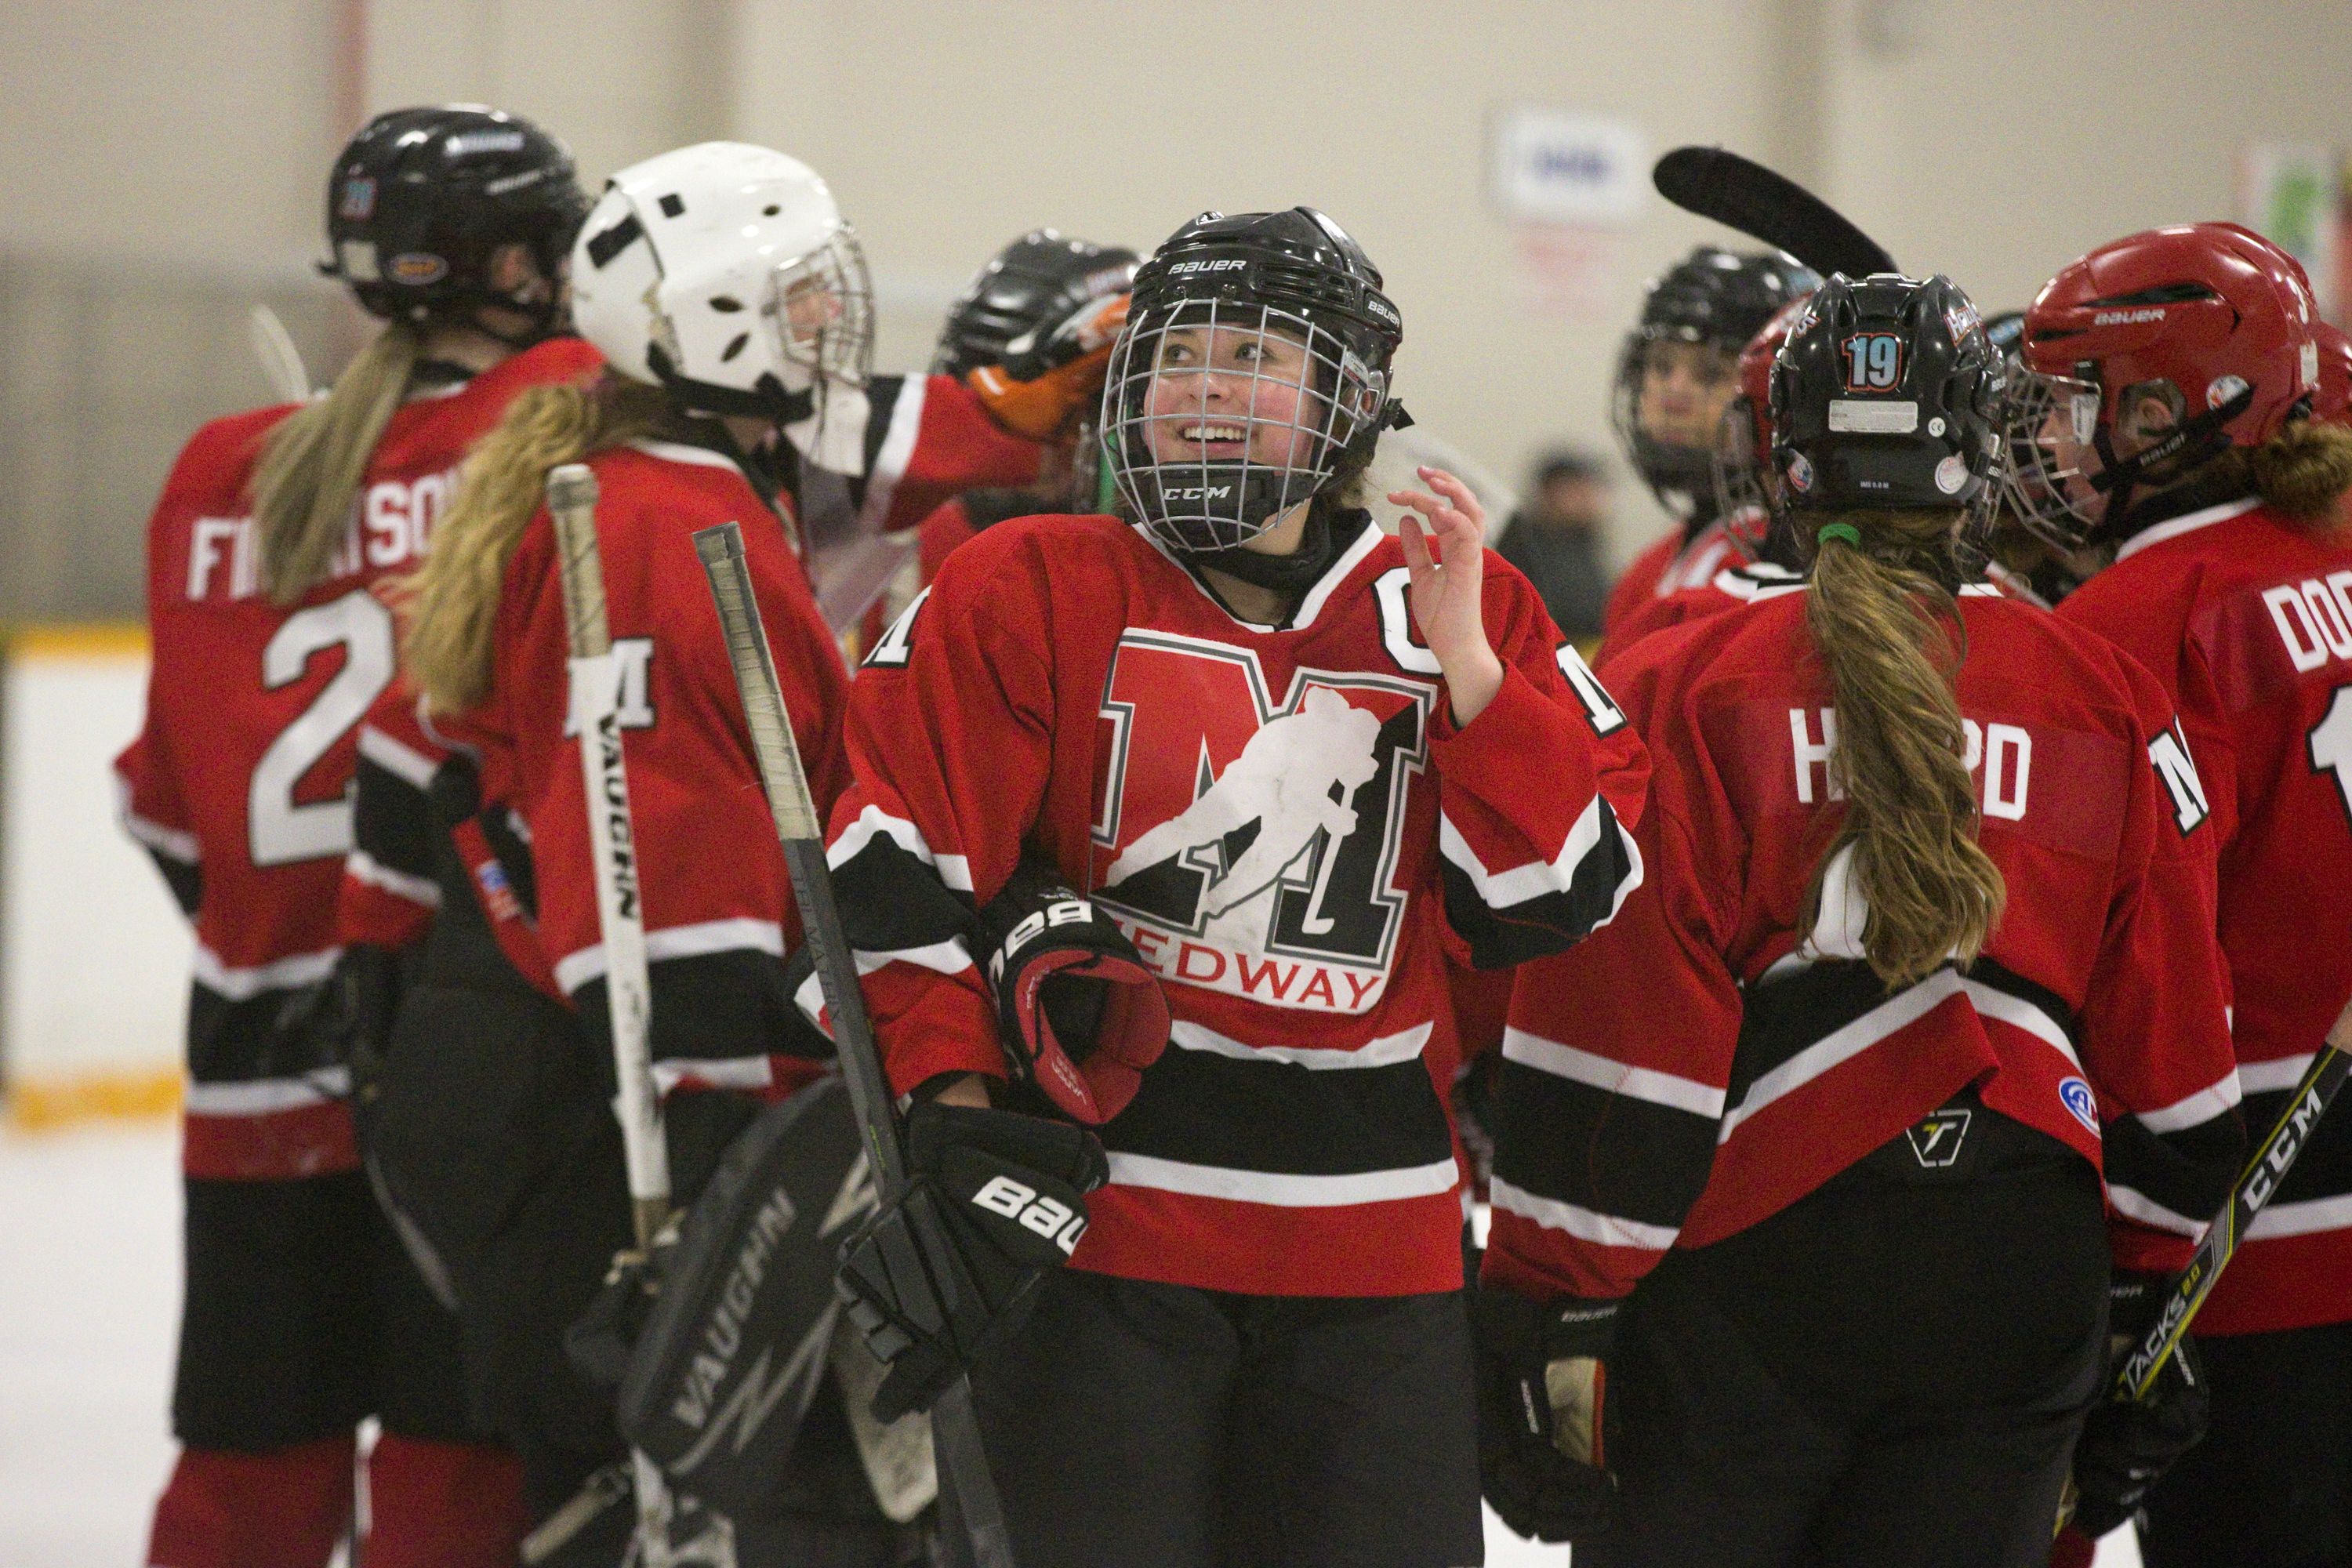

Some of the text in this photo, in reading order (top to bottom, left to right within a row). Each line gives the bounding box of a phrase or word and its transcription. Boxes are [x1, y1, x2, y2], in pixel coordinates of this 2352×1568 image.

[1167, 260, 1247, 275] BAUER
[1367, 300, 1401, 328] BAUER
[1846, 334, 1897, 387] 19
[1163, 485, 1232, 500] CCM
[247, 588, 394, 866] 2
[1113, 918, 1381, 1009] EDWAY
[2243, 1087, 2323, 1211] CCM
[671, 1188, 795, 1428] VAUGHN
